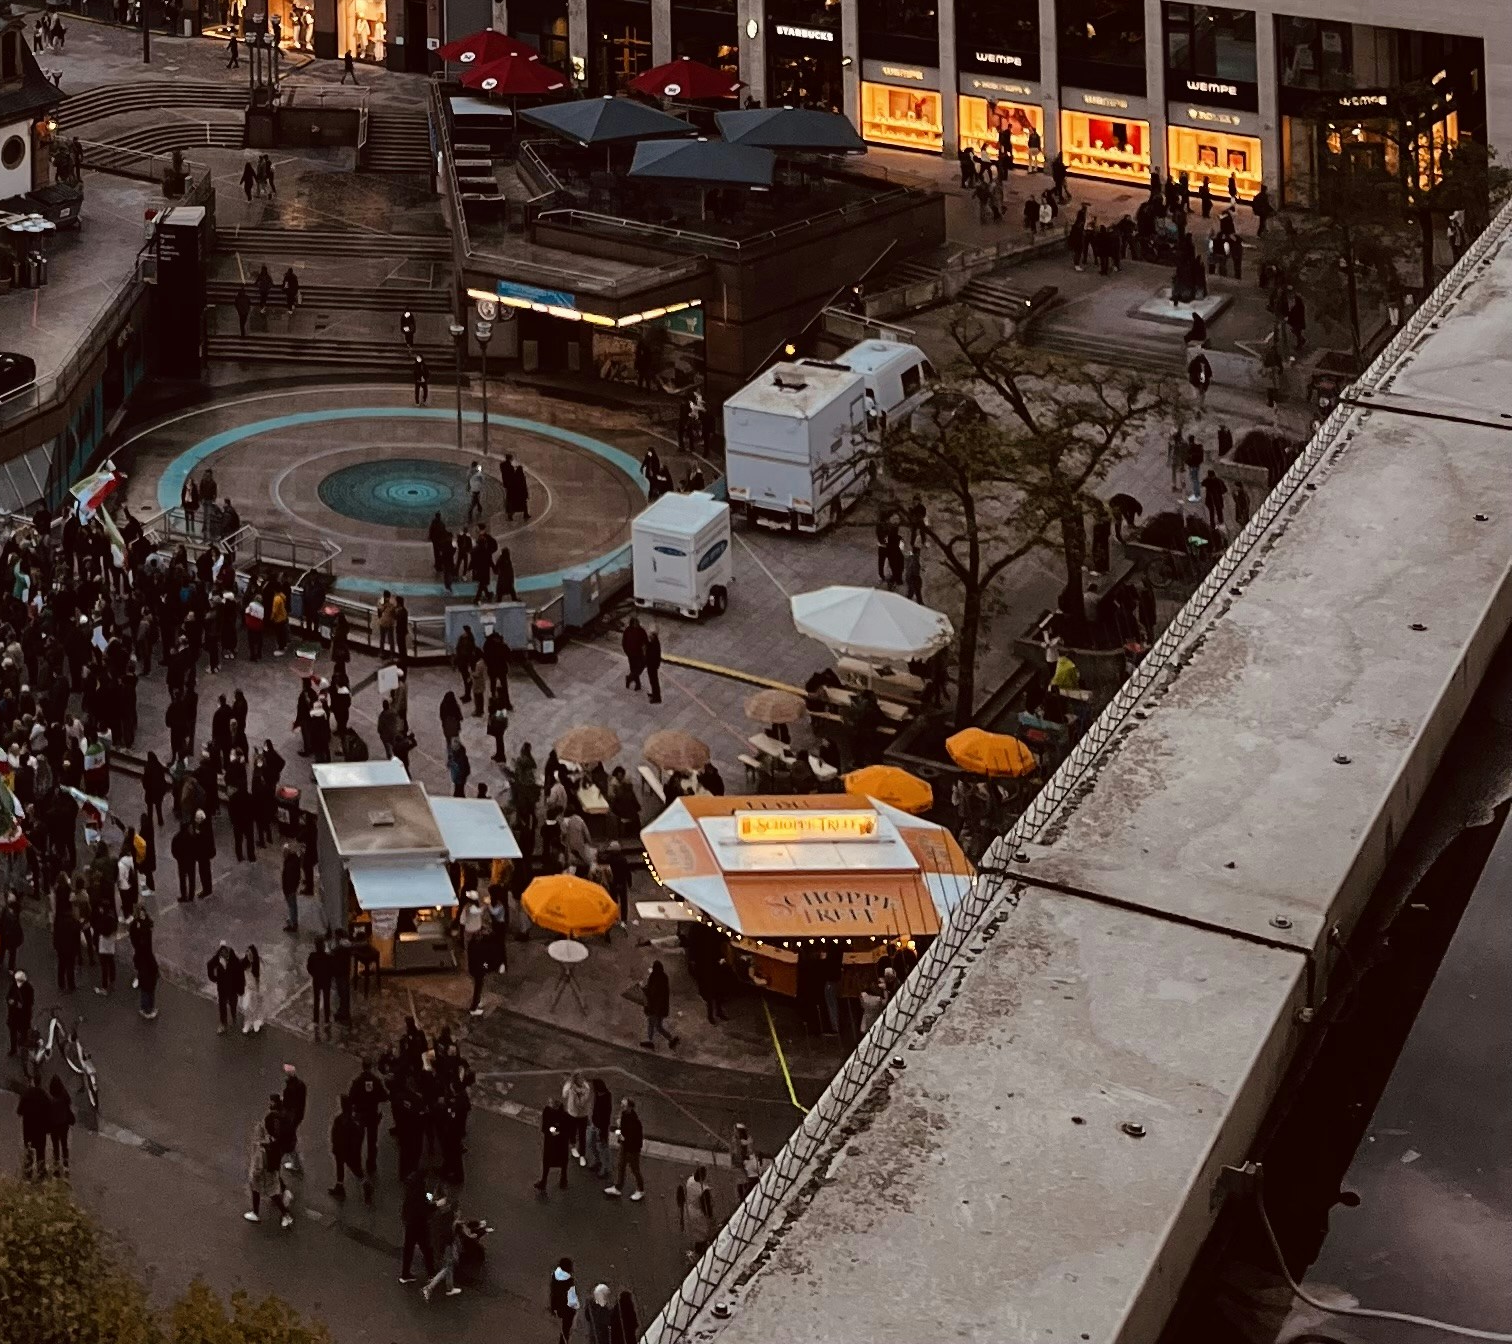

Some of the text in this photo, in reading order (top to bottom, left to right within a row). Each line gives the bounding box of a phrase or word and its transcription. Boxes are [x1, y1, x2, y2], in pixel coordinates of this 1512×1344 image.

[776, 25, 834, 42] STARBUCKS
[975, 51, 1022, 67] WEMPE
[1187, 79, 1238, 96] WEMPE
